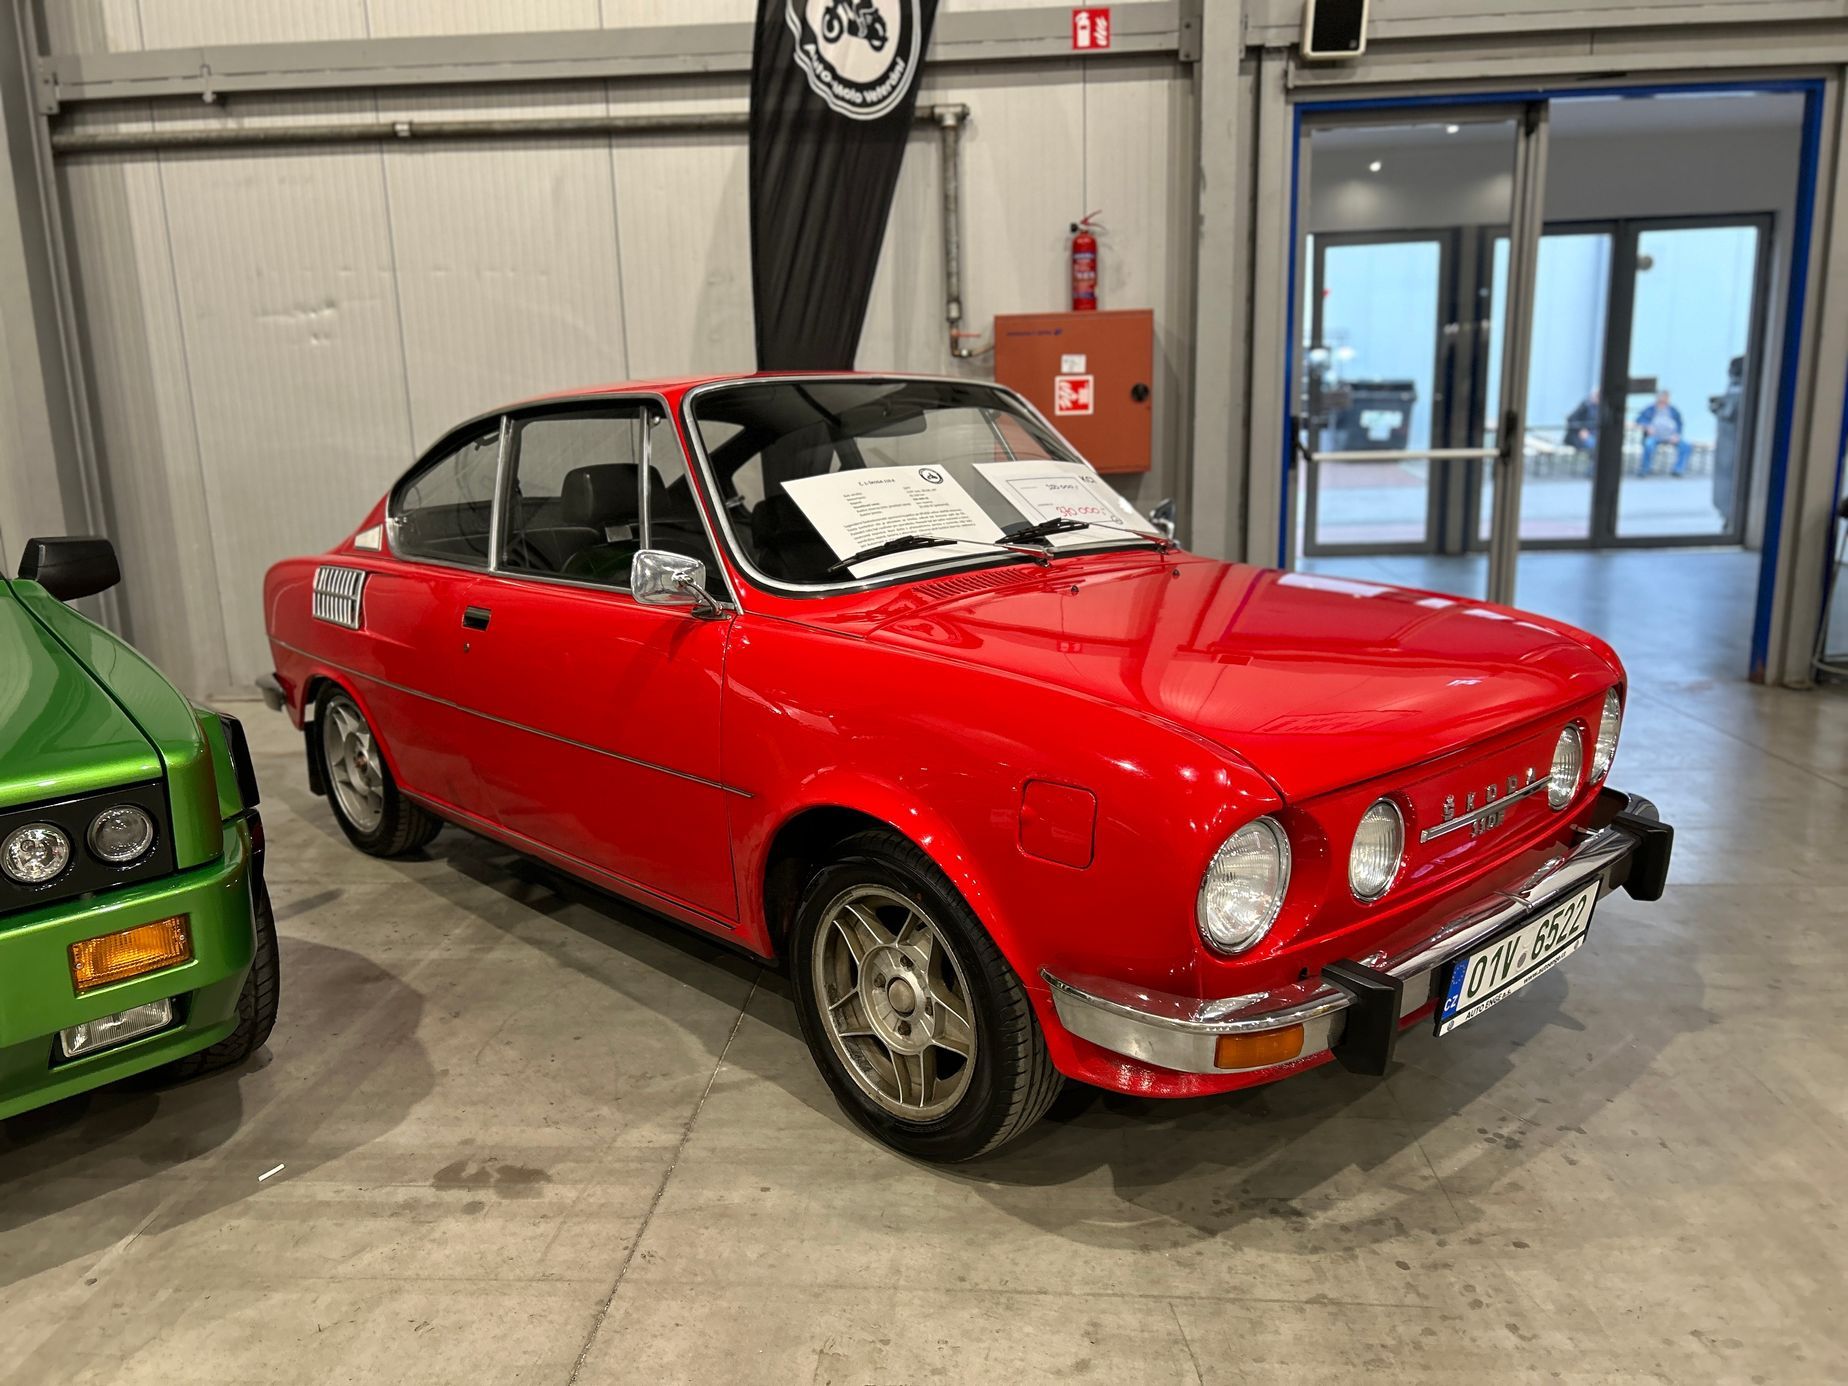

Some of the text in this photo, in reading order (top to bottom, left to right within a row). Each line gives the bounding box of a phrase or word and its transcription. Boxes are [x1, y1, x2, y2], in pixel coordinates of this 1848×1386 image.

[1466, 894, 1587, 999] 01V 6522
[1443, 994, 1459, 1013] CZ
[1465, 1001, 1485, 1020] AUTO
